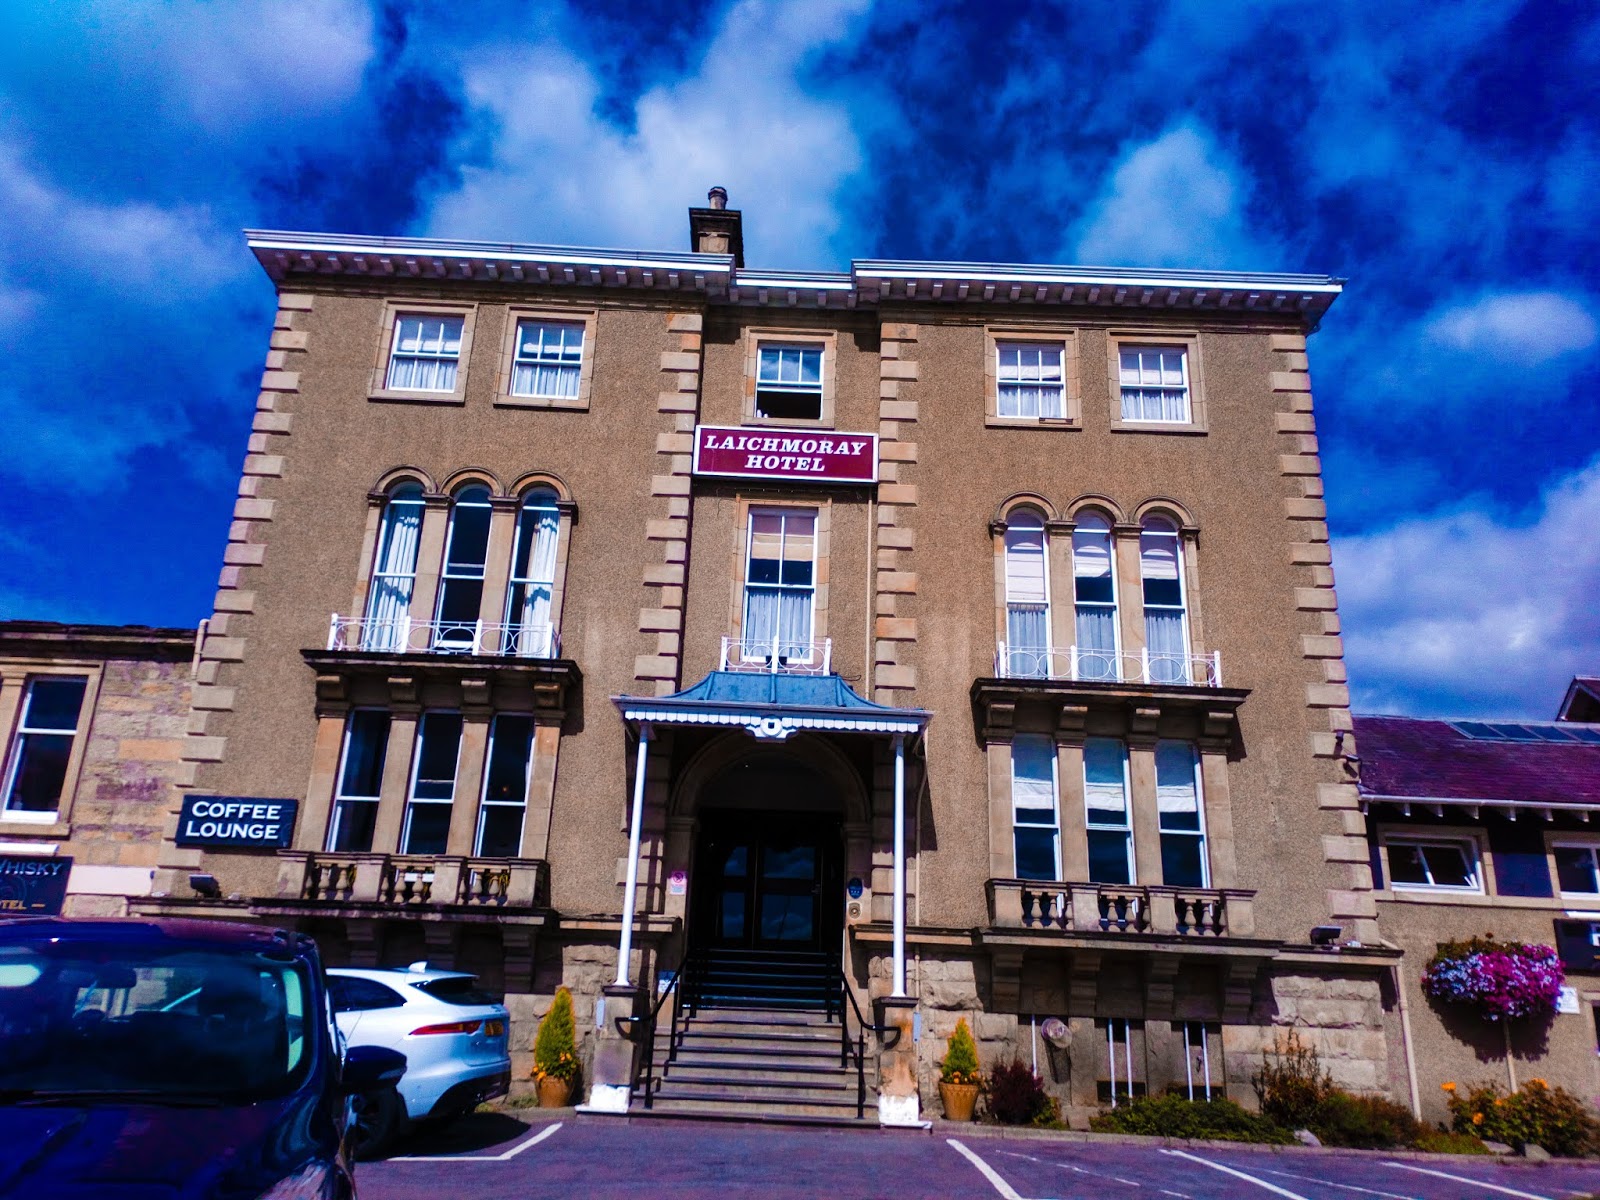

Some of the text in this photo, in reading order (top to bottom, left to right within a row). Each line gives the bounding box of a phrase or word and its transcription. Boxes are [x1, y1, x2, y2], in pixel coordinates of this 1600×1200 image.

[704, 435, 867, 456] LAICHMORAY
[744, 454, 826, 472] HOTEL
[191, 801, 282, 820] COFFEE
[185, 820, 280, 839] LOUNGE
[0, 899, 27, 909] TEL
